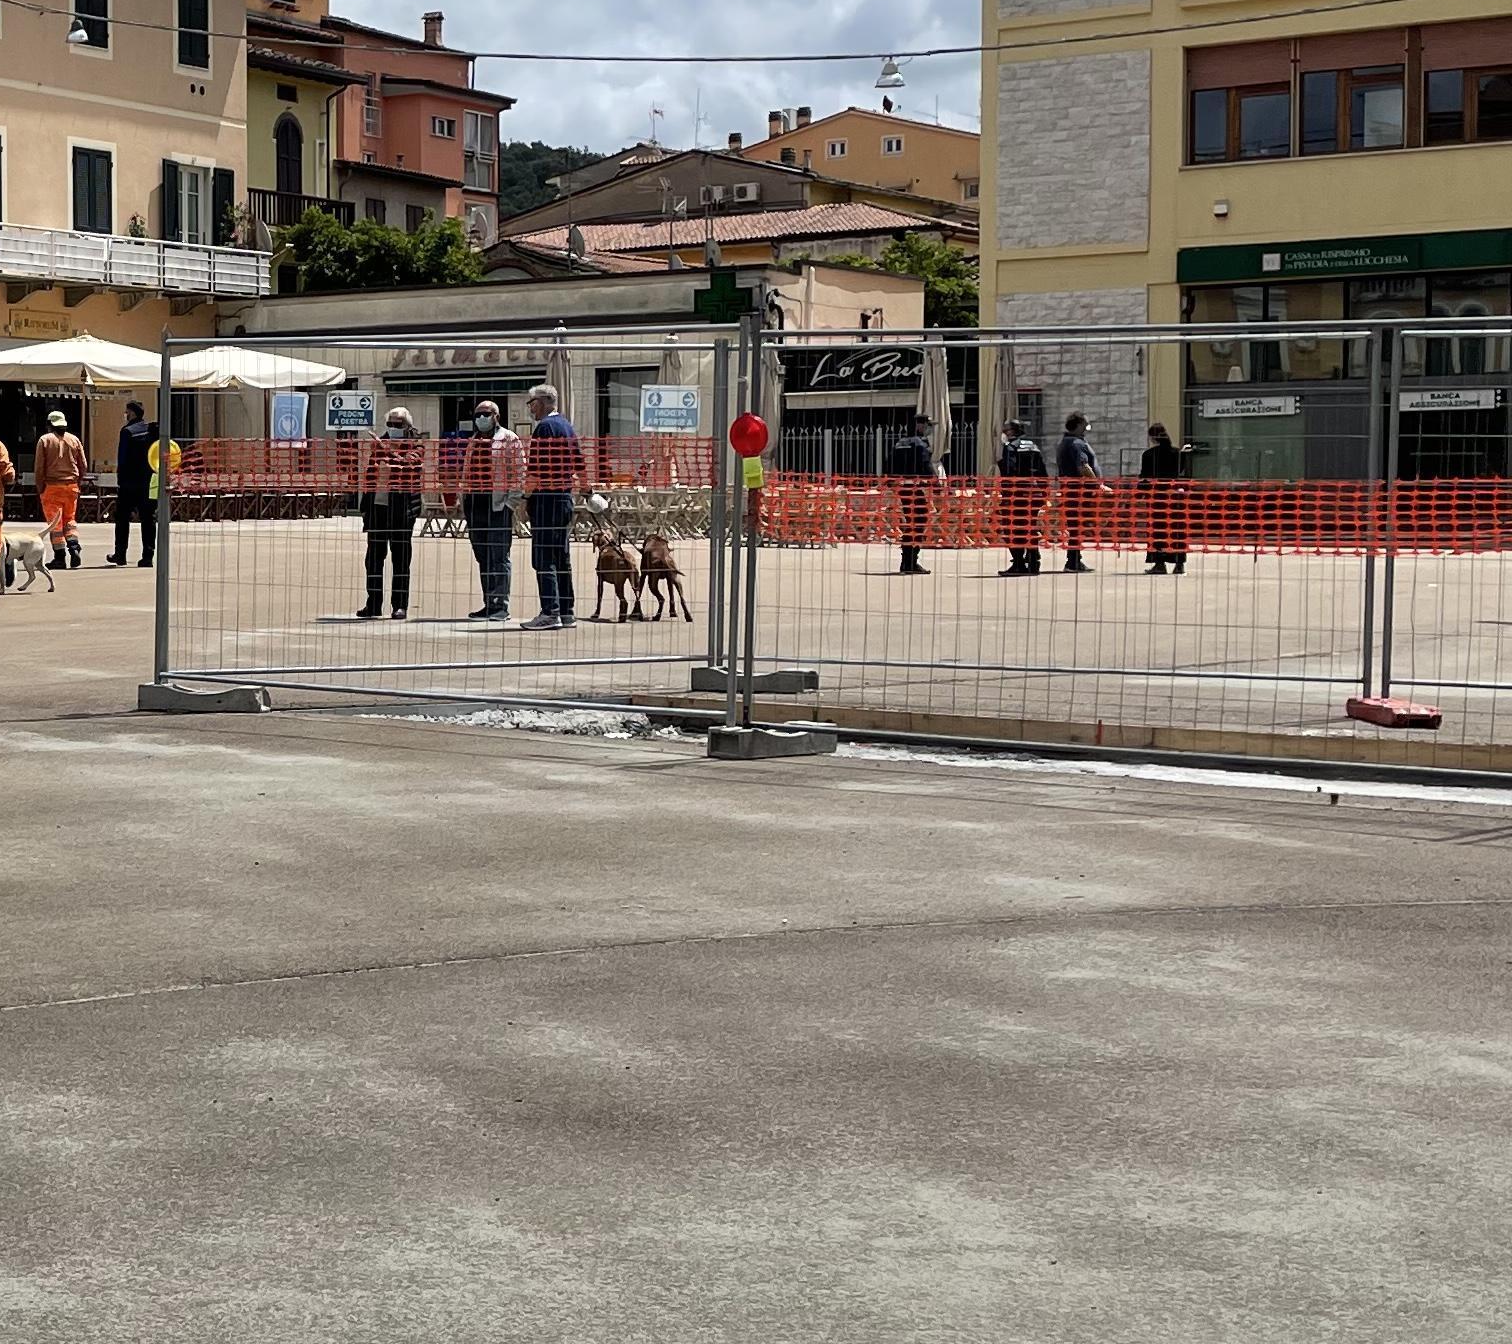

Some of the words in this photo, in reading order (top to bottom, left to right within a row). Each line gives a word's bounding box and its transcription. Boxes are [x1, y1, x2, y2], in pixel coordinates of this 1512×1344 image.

[1285, 252, 1311, 261] CASSA
[1354, 255, 1409, 266] LUCCHESIA
[810, 353, 855, 386] La
[861, 352, 925, 382] Buc
[338, 410, 365, 418] PEDONI
[340, 417, 369, 425] DESTRA
